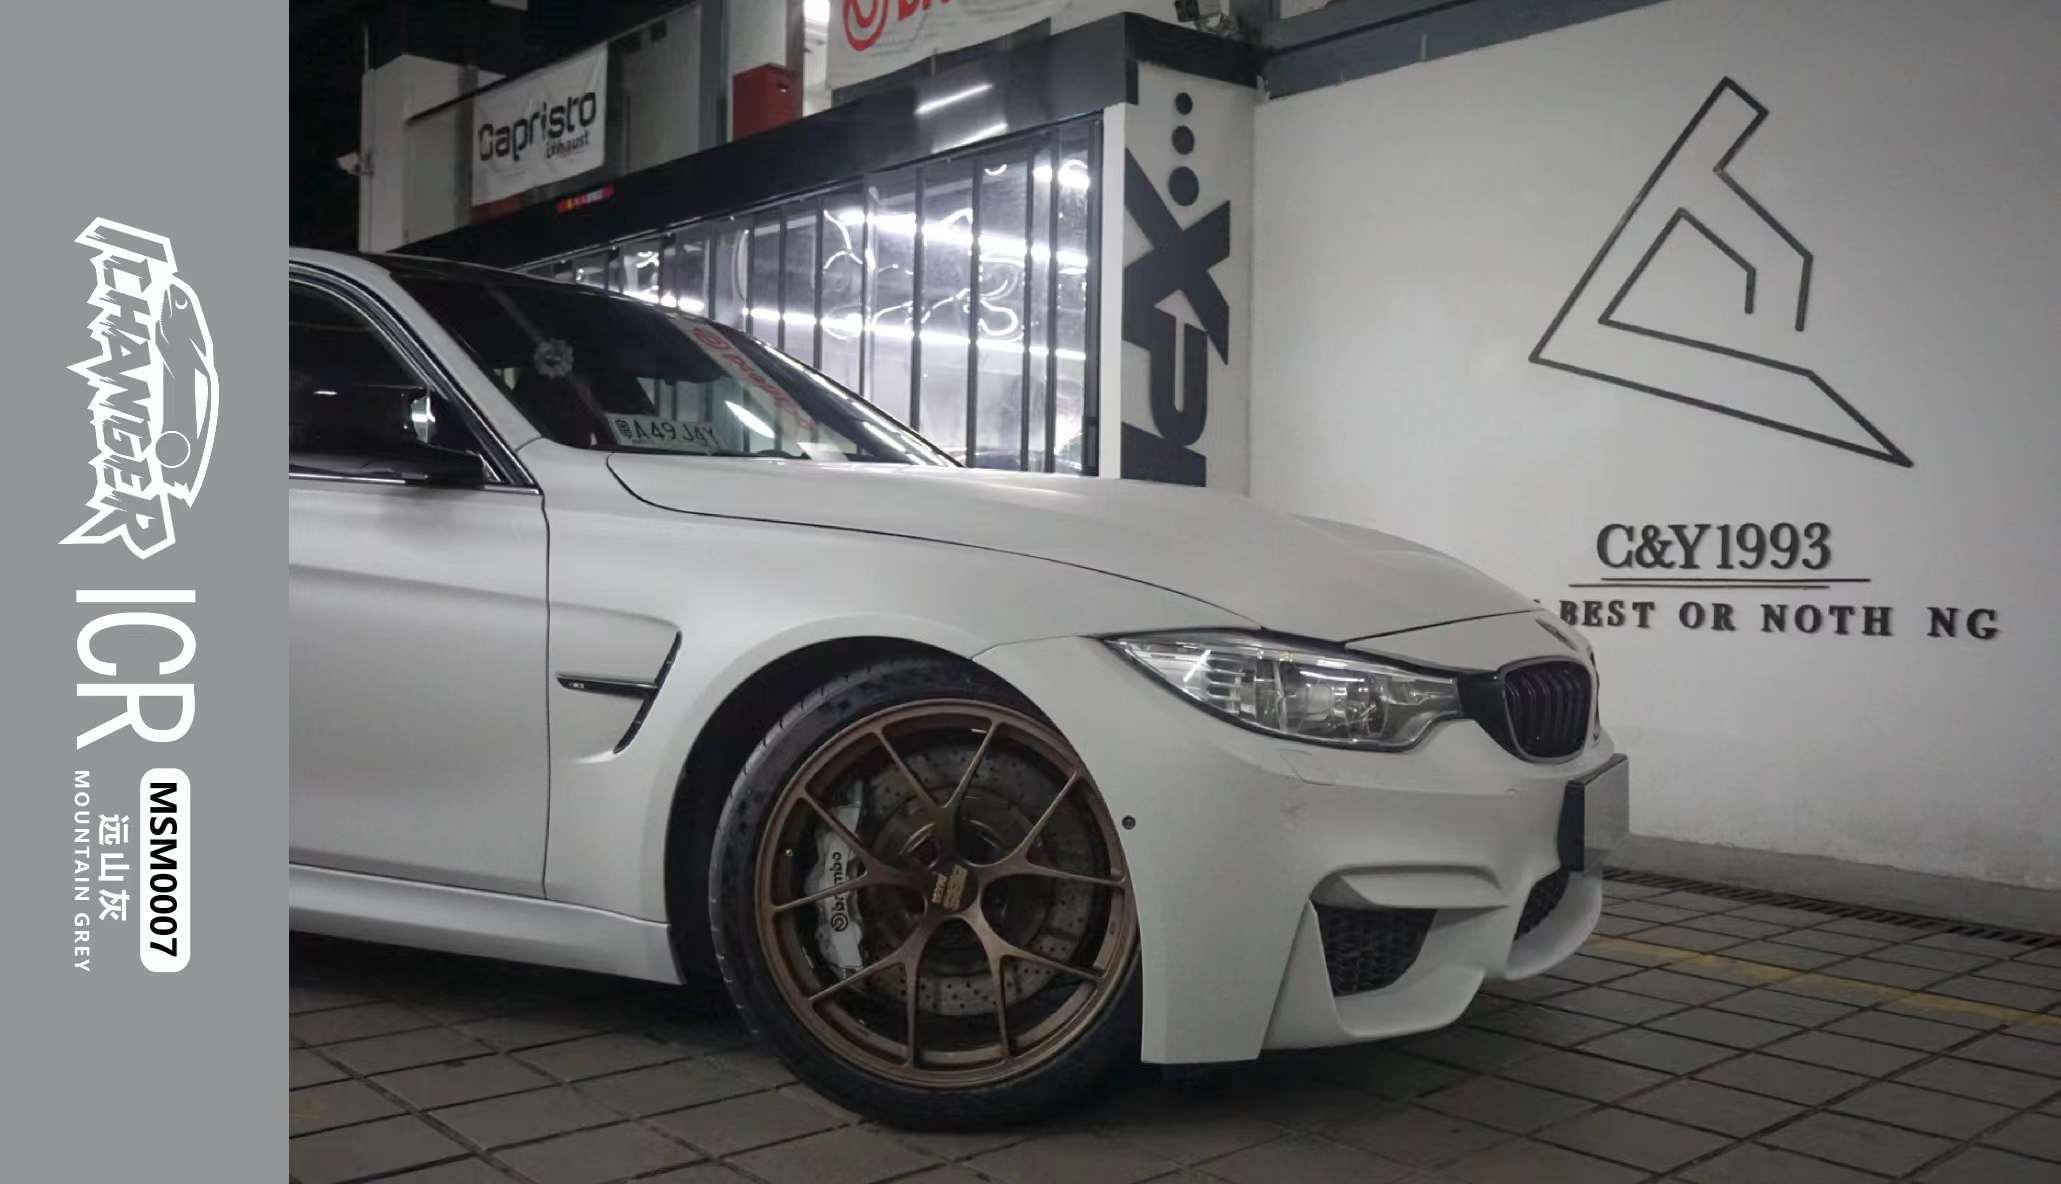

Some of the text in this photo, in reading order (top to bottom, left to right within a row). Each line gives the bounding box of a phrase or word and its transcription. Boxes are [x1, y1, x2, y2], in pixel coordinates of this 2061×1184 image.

[477, 91, 597, 162] Capristo
[1559, 600, 1656, 629] BEST
[1679, 602, 1736, 632] OR
[831, 851, 846, 911] brmbo
